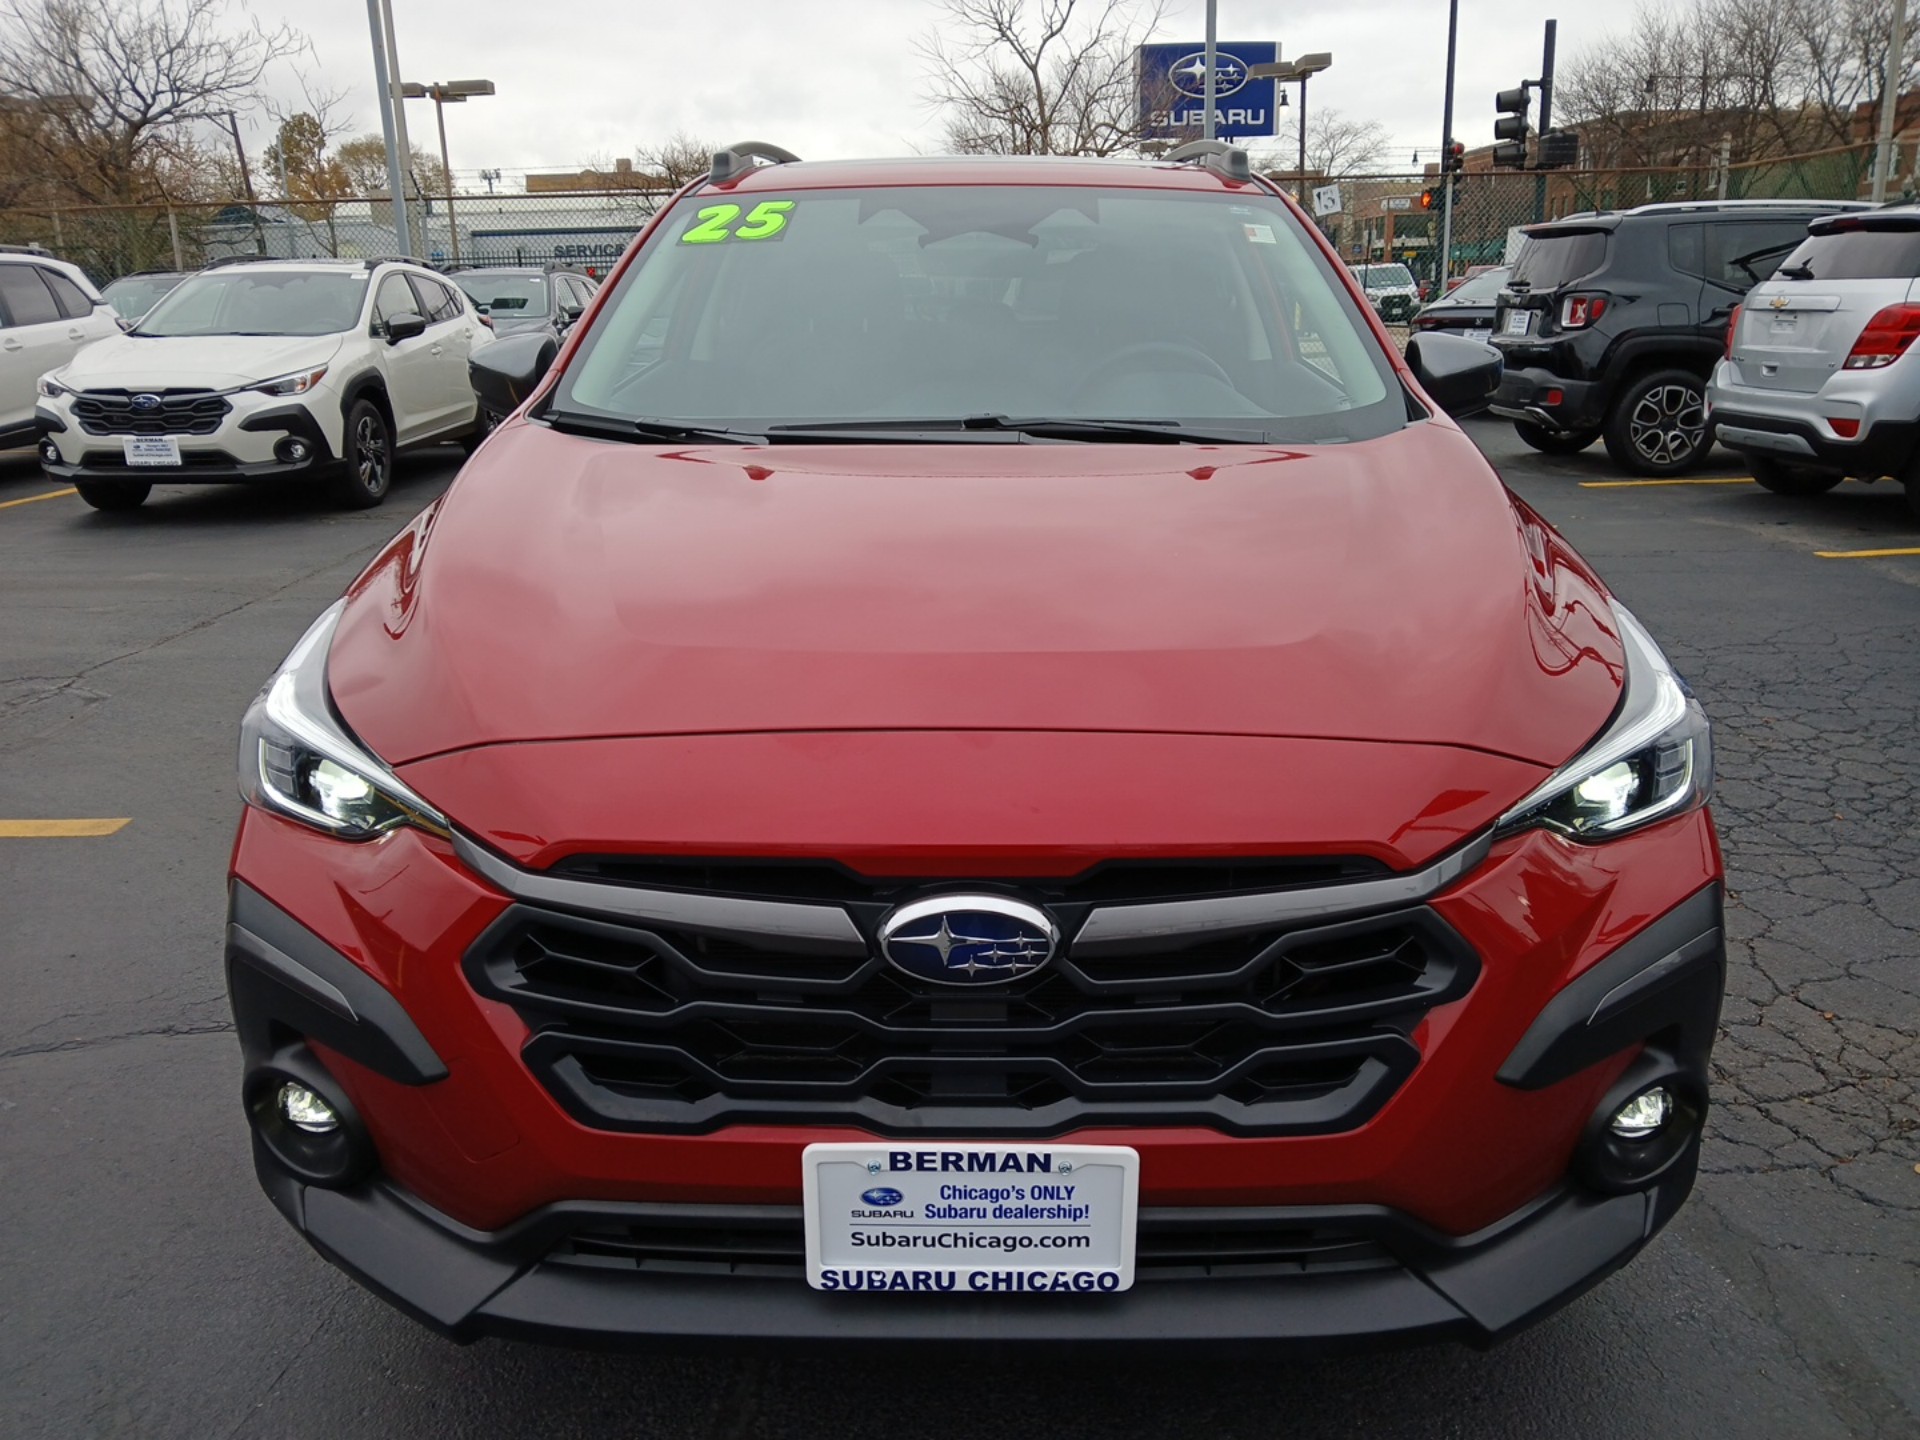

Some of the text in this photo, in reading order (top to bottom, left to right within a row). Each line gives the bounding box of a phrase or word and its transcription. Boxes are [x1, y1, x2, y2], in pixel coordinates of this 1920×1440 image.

[1150, 109, 1265, 126] SUBARU
[682, 200, 796, 244] 25
[555, 244, 626, 257] SERVICE
[889, 1151, 1052, 1173] BERMAN
[940, 1184, 1076, 1204] Chicago's ONLY
[851, 1209, 914, 1219] SUBARU
[924, 1203, 1090, 1222] Subaru dealership!
[850, 1231, 1091, 1253] SubaruChicago.com
[820, 1270, 1120, 1292] SUBARU CHICAGO
